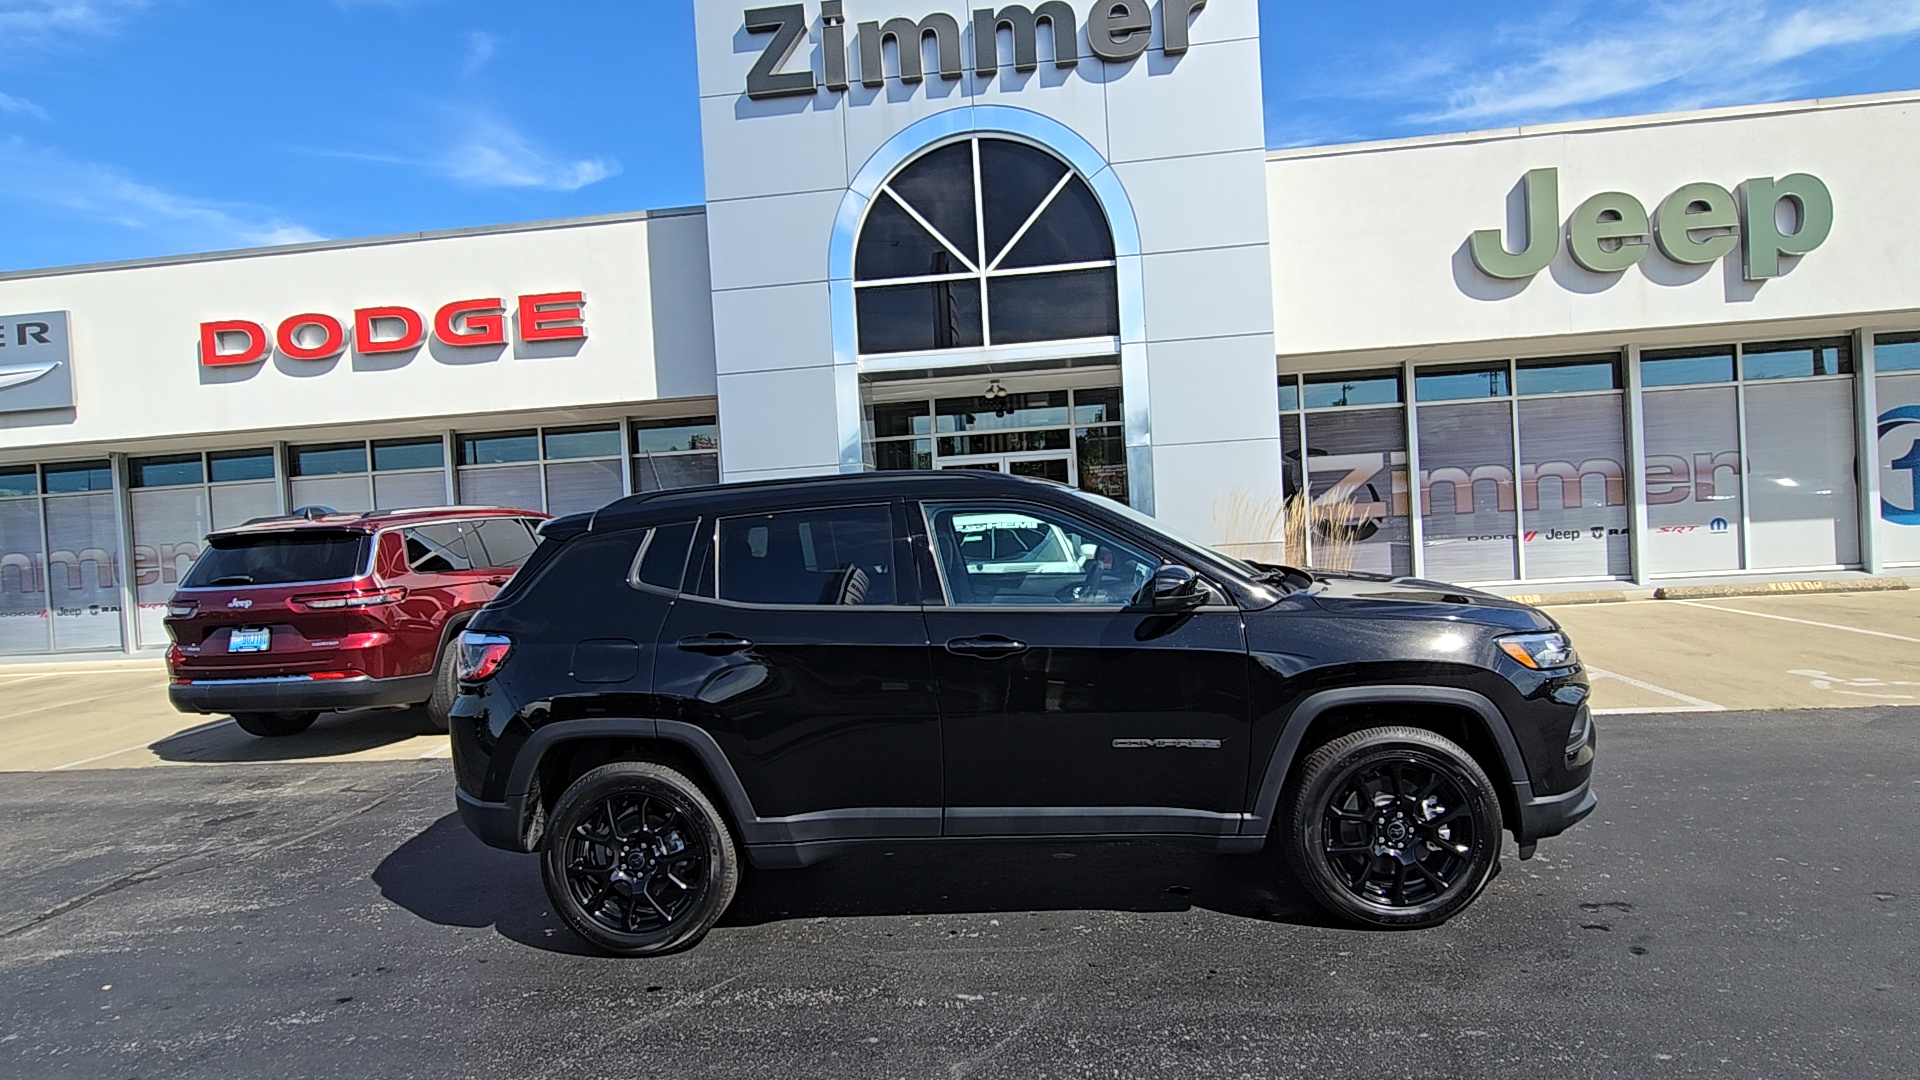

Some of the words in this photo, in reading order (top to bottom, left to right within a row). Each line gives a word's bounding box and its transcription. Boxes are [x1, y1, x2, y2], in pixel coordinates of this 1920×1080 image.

[744, 0, 1208, 99] Zimmer
[1470, 166, 1834, 281] Jeep
[0, 321, 52, 346] R
[200, 290, 588, 368] DODGE
[1304, 450, 1751, 519] Zimmer
[1545, 528, 1580, 541] Jeep
[1656, 525, 1700, 534] SRT
[1768, 581, 1824, 591] VISITOR
[57, 606, 82, 617] Jeep
[228, 597, 253, 609] Jeep
